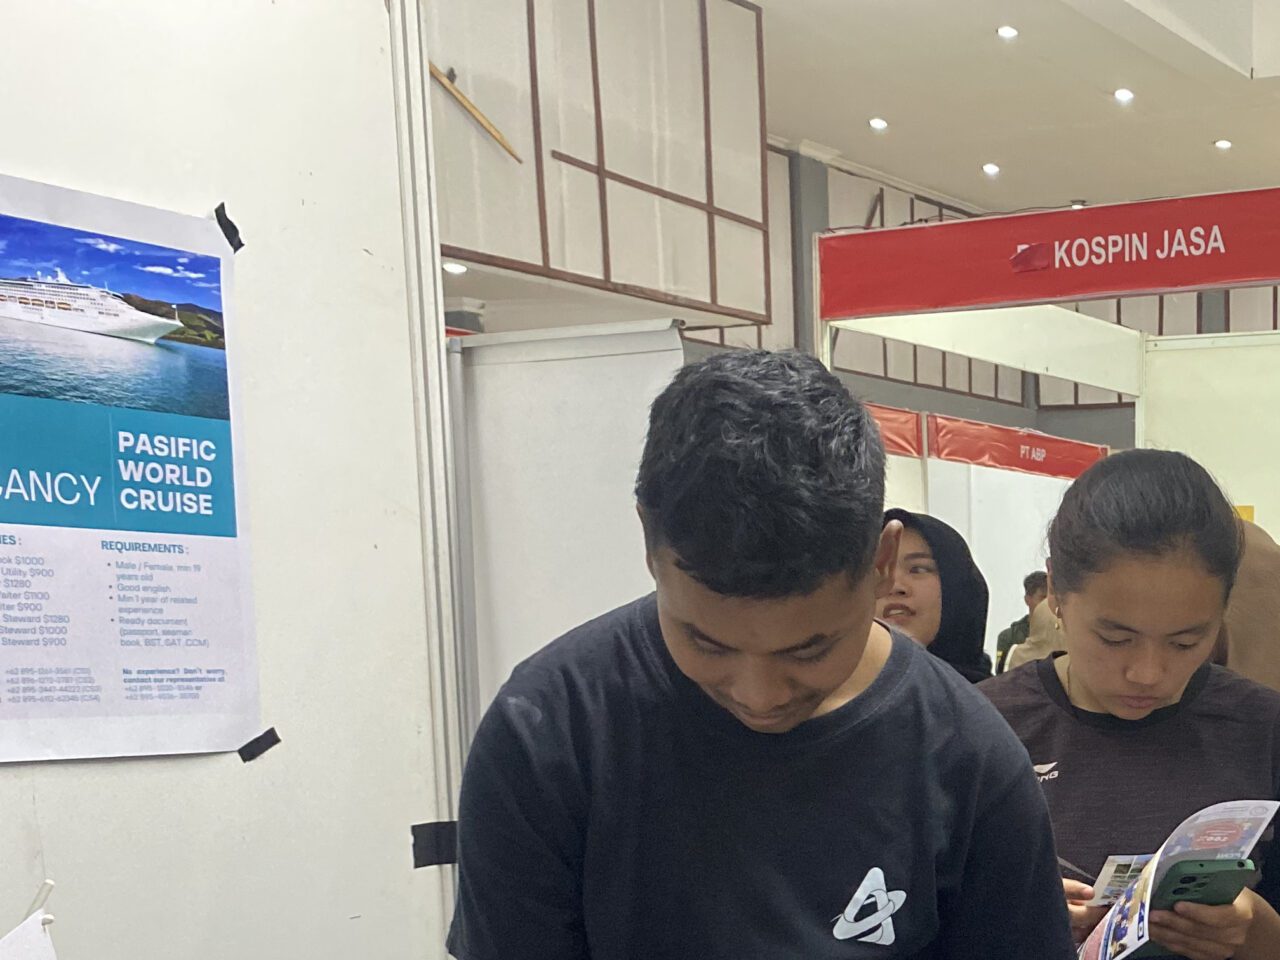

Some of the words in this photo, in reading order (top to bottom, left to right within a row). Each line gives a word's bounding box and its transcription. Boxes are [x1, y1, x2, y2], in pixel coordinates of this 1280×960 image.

[1054, 232, 1148, 269] KOSPIN
[1156, 225, 1226, 260] JASA
[117, 431, 217, 461] PASIFIC
[1020, 444, 1030, 460] PT
[0, 468, 101, 506] ANCY
[117, 459, 213, 488] WORLD
[120, 488, 213, 515] CRUISE
[29, 568, 54, 578] $900
[0, 591, 21, 599] aiter
